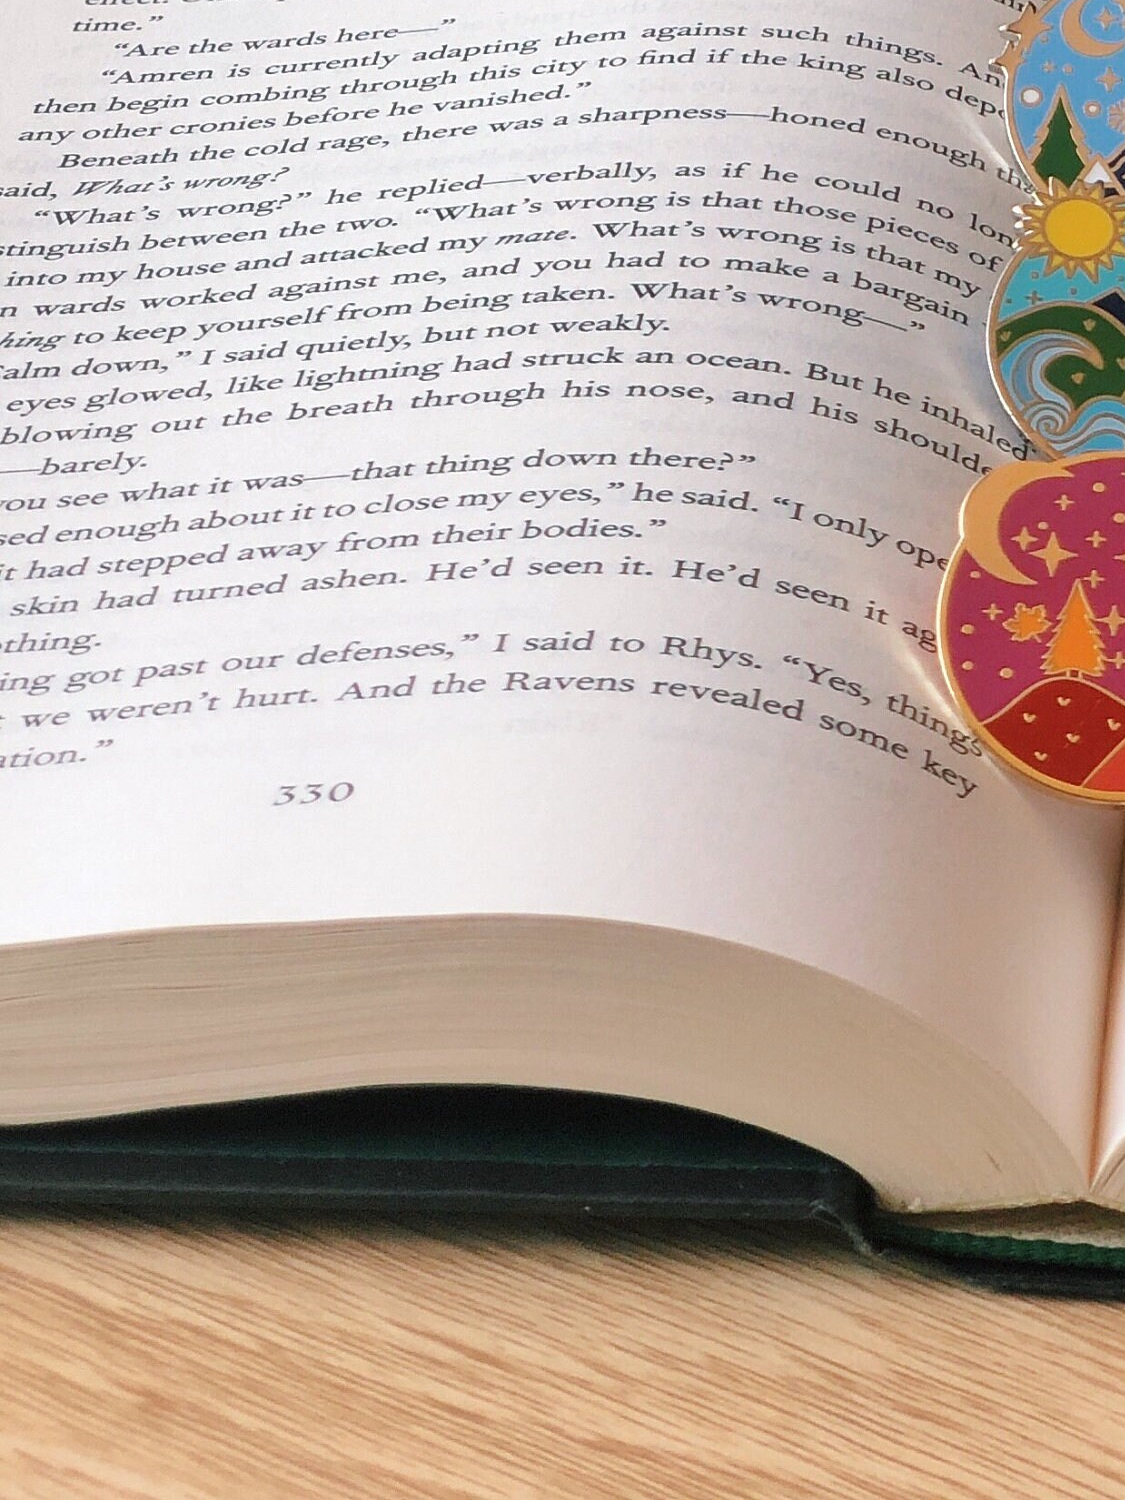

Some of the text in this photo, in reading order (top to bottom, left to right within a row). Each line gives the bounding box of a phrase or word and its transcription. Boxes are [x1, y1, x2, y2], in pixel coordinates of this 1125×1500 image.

[17, 130, 76, 146] any
[82, 122, 164, 140] other
[169, 115, 277, 136] cronies
[282, 106, 381, 127] before
[386, 100, 424, 117] he
[56, 147, 179, 169] Beneath
[189, 144, 236, 162] the
[243, 136, 310, 157] cold
[316, 134, 390, 153] rage,
[402, 124, 478, 143] there
[487, 117, 545, 133] was
[552, 115, 569, 127] a
[875, 127, 986, 173] enough
[5, 396, 77, 418] eyes
[82, 379, 213, 413] glowed,
[224, 374, 285, 395] like
[292, 361, 445, 392] lightning
[450, 350, 513, 373] had
[521, 345, 625, 368] struck
[634, 351, 675, 365] an
[685, 353, 792, 376] ocean.
[804, 362, 865, 391] But
[872, 377, 911, 406] he
[21, 711, 71, 728] we
[232, 687, 318, 709] hurt.
[334, 675, 417, 702] And
[431, 672, 487, 695] the
[501, 671, 636, 693] Ravens
[649, 681, 805, 722] revealed
[818, 714, 909, 760] some
[920, 749, 979, 799] key
[272, 781, 355, 807] 330
